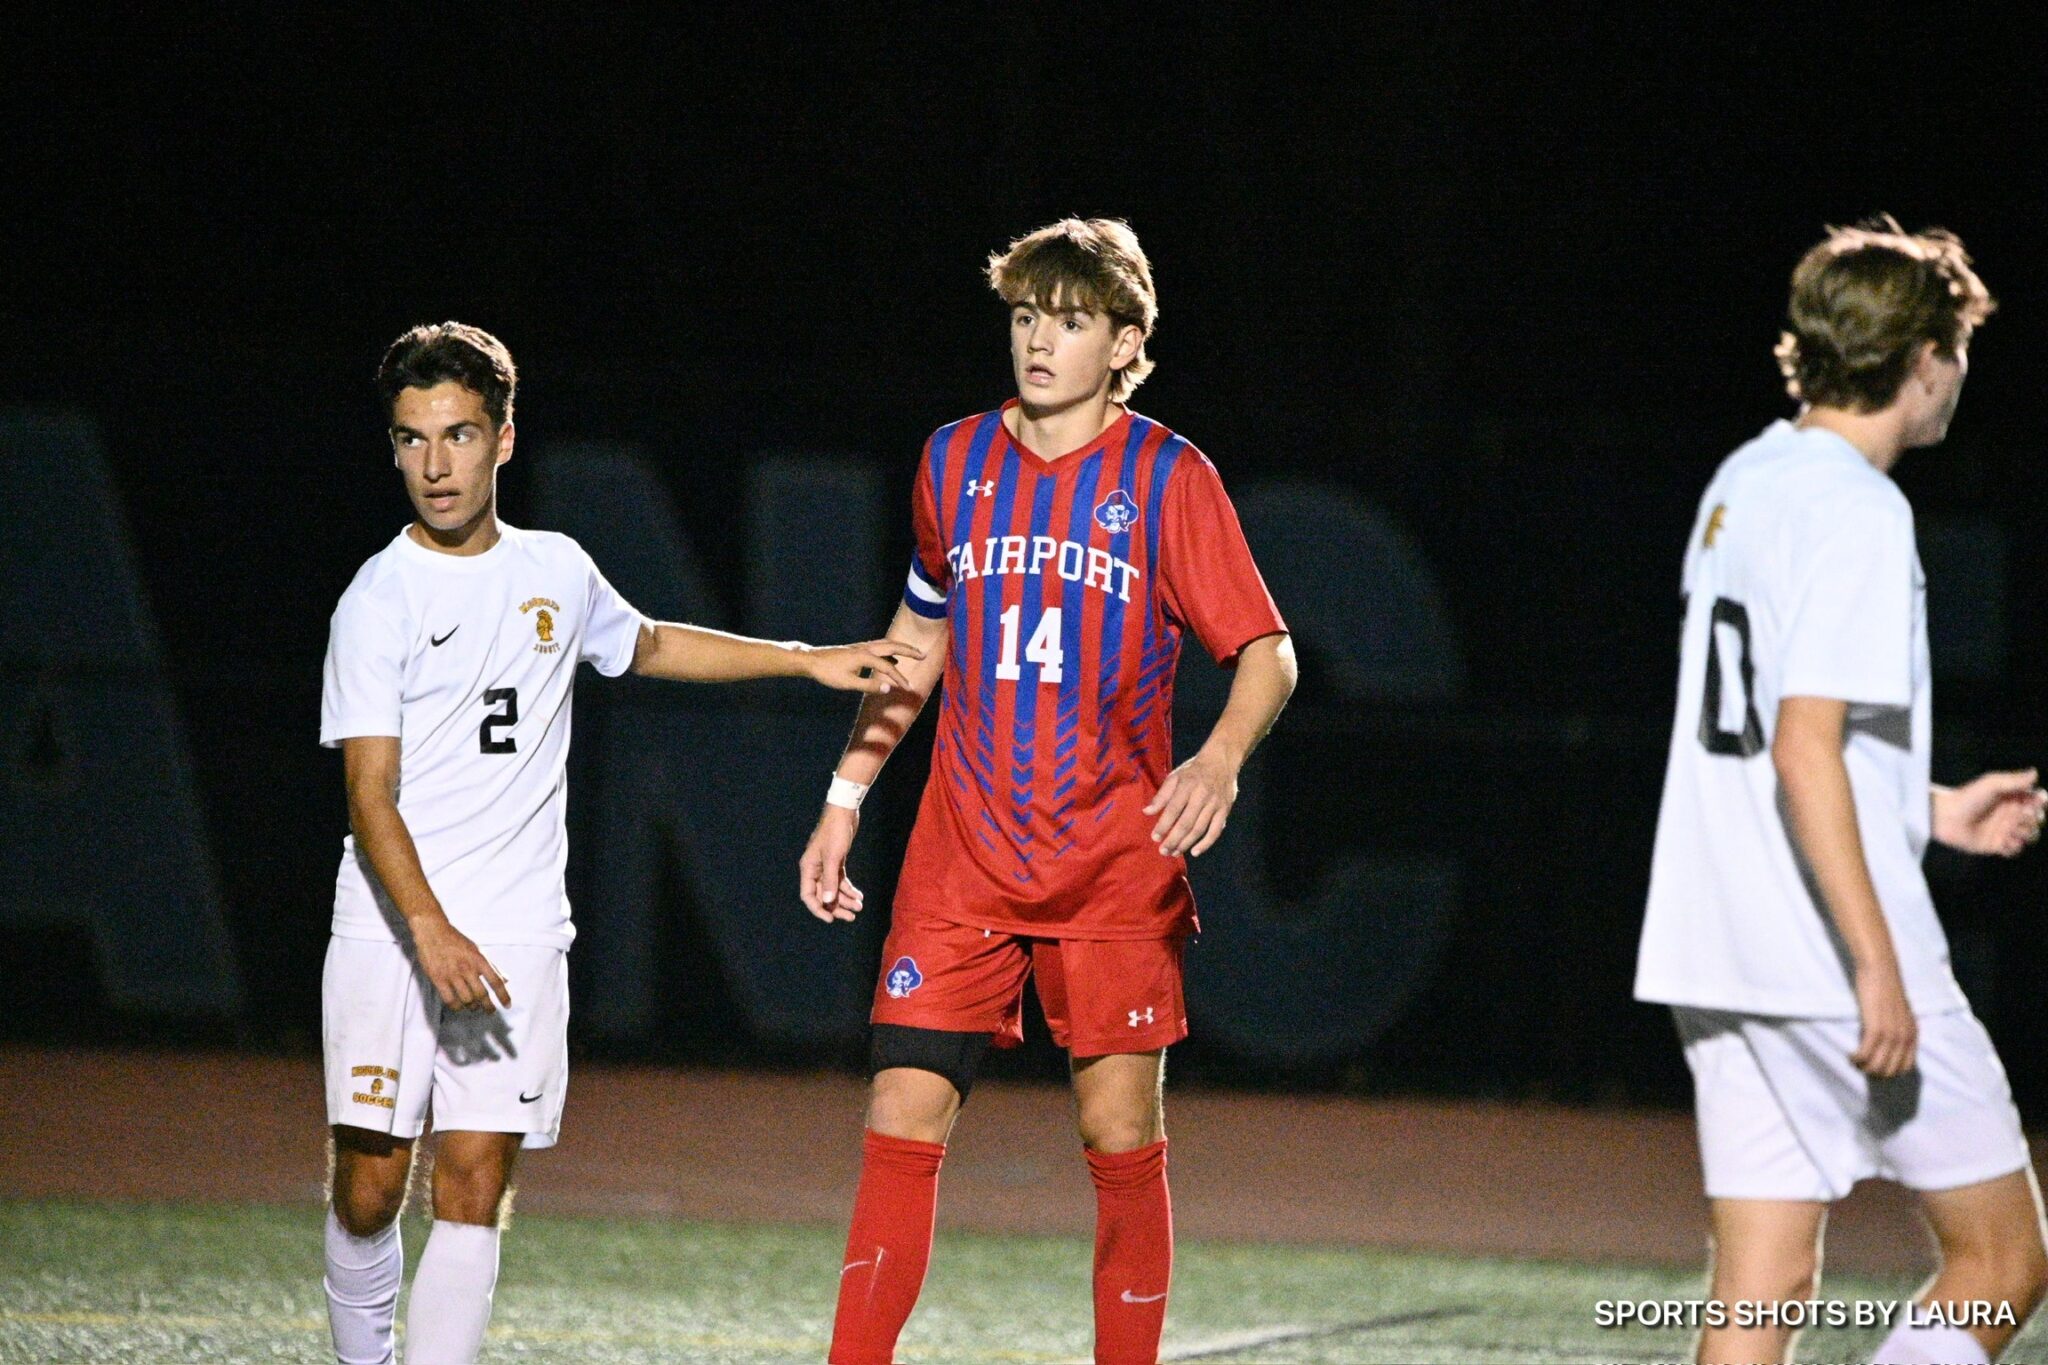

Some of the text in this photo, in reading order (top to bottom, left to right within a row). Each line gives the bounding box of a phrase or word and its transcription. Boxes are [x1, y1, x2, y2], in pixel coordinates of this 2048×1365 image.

[947, 535, 1140, 603] FAIRPORT
[995, 604, 1064, 684] 14
[479, 687, 519, 754] 2
